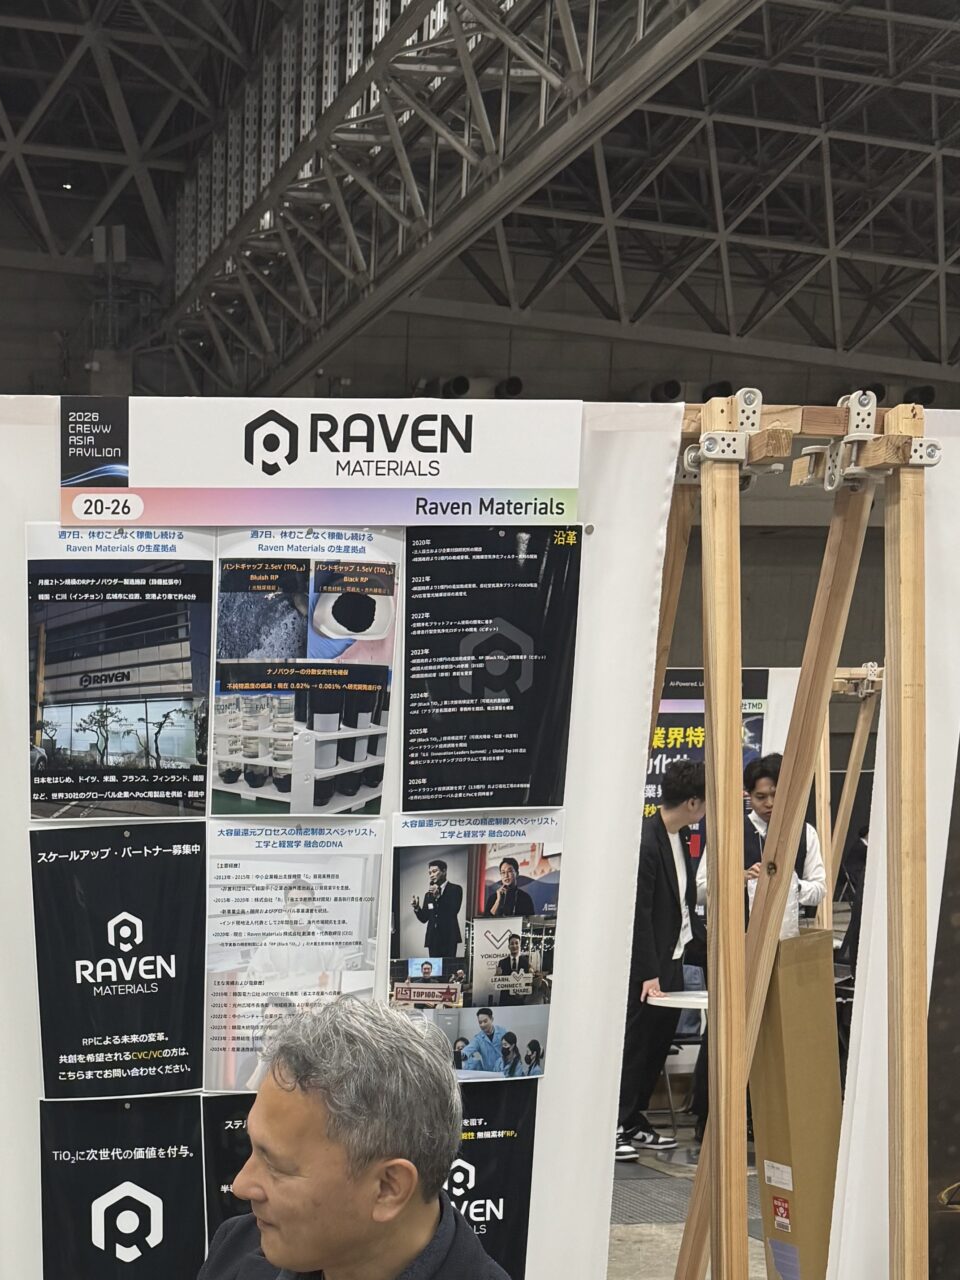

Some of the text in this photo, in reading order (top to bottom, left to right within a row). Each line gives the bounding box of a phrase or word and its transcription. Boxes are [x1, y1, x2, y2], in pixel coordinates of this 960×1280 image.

[68, 412, 99, 422] 2026
[68, 424, 112, 434] CREWW
[309, 413, 473, 453] RAVEN
[68, 435, 95, 445] ASIA
[68, 447, 121, 457] PAVILION
[336, 460, 440, 477] MATERIALS
[83, 498, 131, 515] 20-26
[415, 497, 565, 516] Raven Materials
[58, 530, 184, 540] 週7日、休むことなく稼働し続ける
[250, 530, 374, 542] 週7日、休むことなく稼働し続ける
[553, 530, 578, 546] 沿革
[66, 544, 177, 553] Raven Materials の生産拠点
[258, 543, 366, 554] Raven Materials の生産拠点
[93, 671, 131, 685] RAVEN
[651, 726, 705, 749] 業界特
[440, 829, 527, 839] 工学と経営学 融合のDNA
[255, 840, 344, 849] 工学と経営学 融合のDNA
[37, 843, 201, 863] スケールアップ・パートナー募集中
[75, 954, 176, 984] RAVEN
[93, 982, 159, 996] MATERIALS
[82, 1032, 170, 1046] RPによる未来の変革。
[58, 1064, 191, 1081] こちらまでお問い合わせください。
[450, 1198, 504, 1222] VEN
